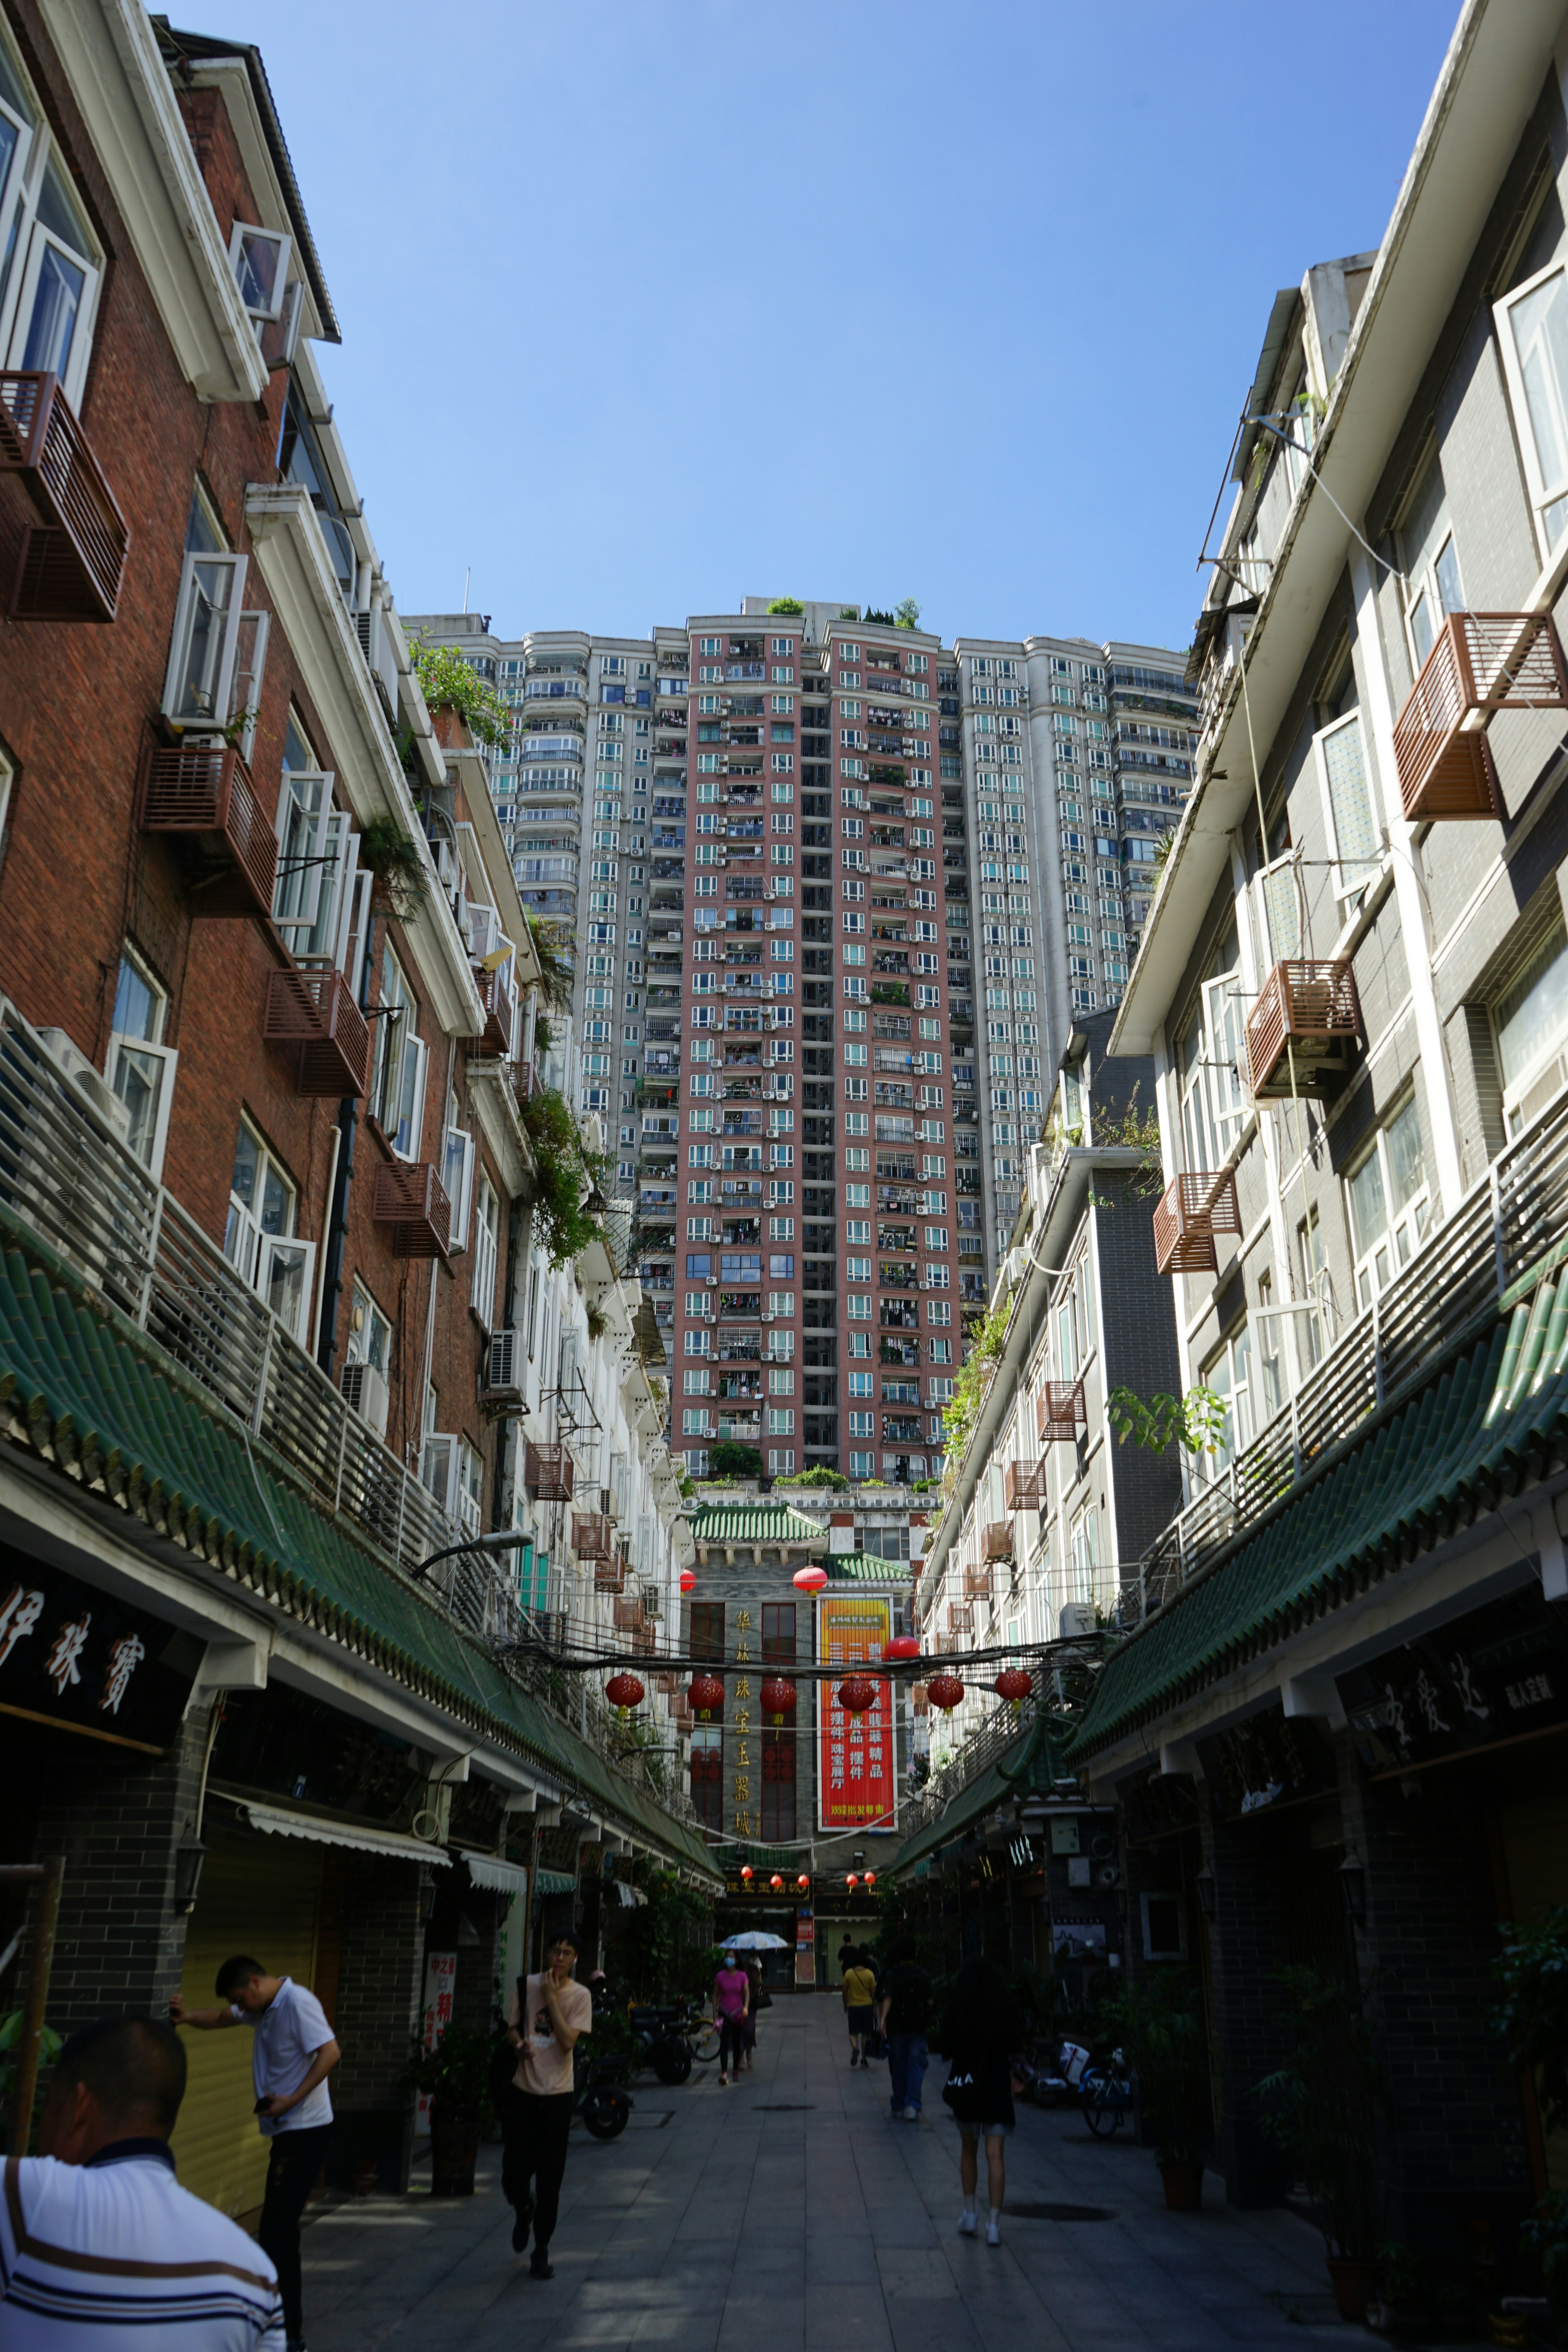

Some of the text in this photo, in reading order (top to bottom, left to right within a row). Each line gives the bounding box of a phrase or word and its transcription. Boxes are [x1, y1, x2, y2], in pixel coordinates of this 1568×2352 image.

[734, 1610, 751, 1837] 华林珠宝玉器城
[831, 1804, 884, 1815] 欢迎批发零售
